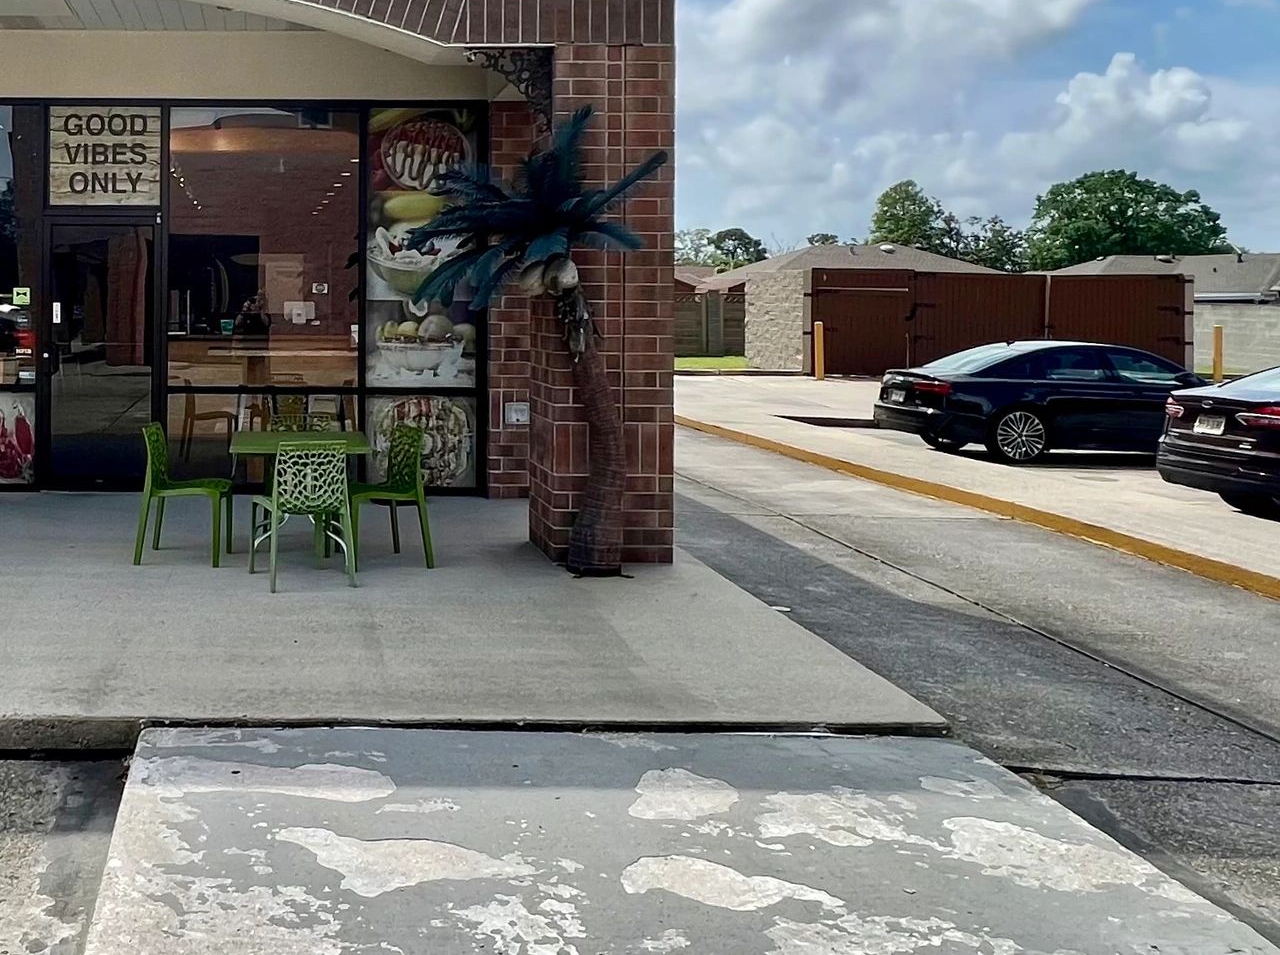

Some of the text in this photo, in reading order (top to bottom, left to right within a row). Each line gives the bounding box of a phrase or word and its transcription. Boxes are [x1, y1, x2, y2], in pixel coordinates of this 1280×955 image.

[63, 113, 148, 136] GOOD
[64, 142, 148, 165] VIBES
[68, 171, 144, 195] ONLY
